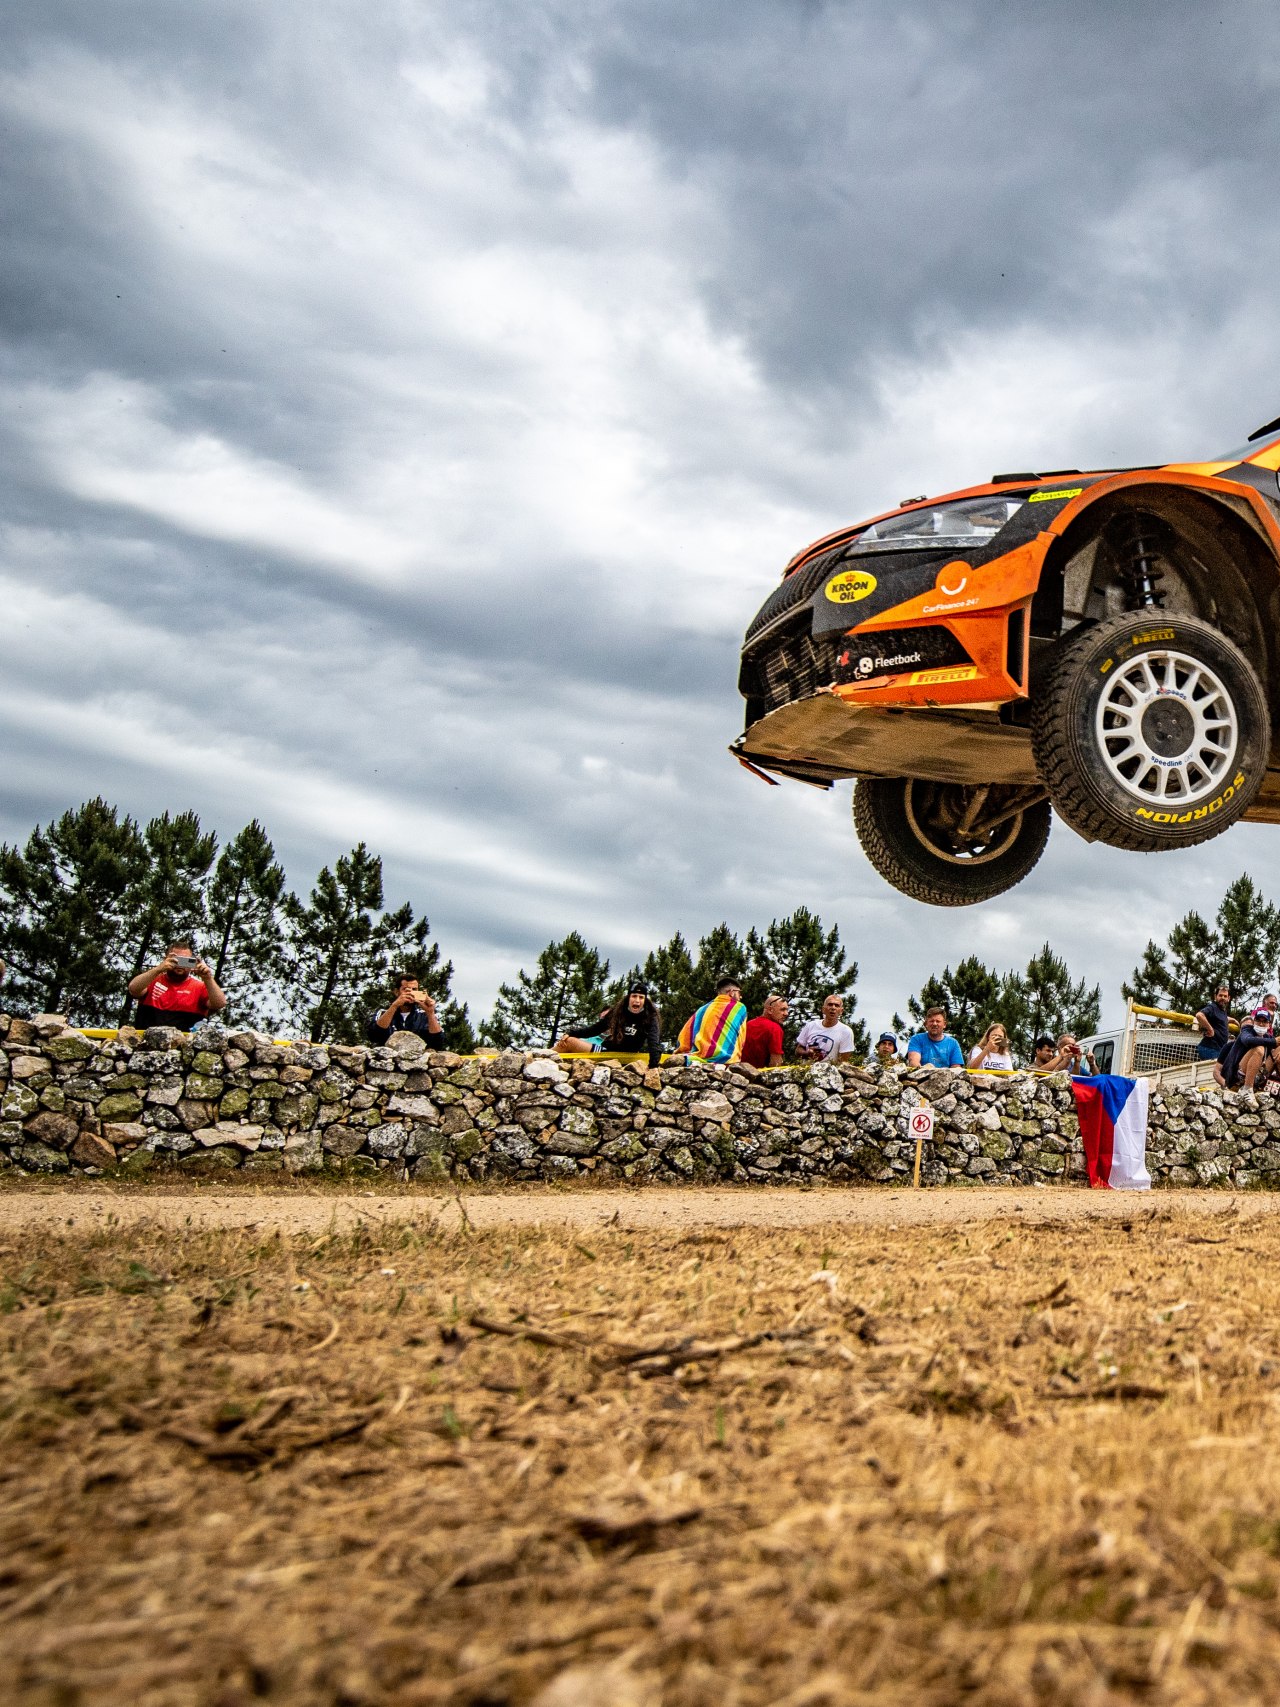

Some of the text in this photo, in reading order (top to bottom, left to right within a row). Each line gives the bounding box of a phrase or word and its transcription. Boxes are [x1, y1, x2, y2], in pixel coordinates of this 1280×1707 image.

[831, 581, 868, 594] KROON
[839, 590, 855, 601] OIL
[922, 601, 965, 613] CarFinance
[1131, 628, 1175, 645] PIRELLI
[874, 651, 921, 668] Fleetback
[917, 668, 971, 683] PIRELLI
[1150, 755, 1183, 767] speedline
[1135, 771, 1246, 825] SCORPION
